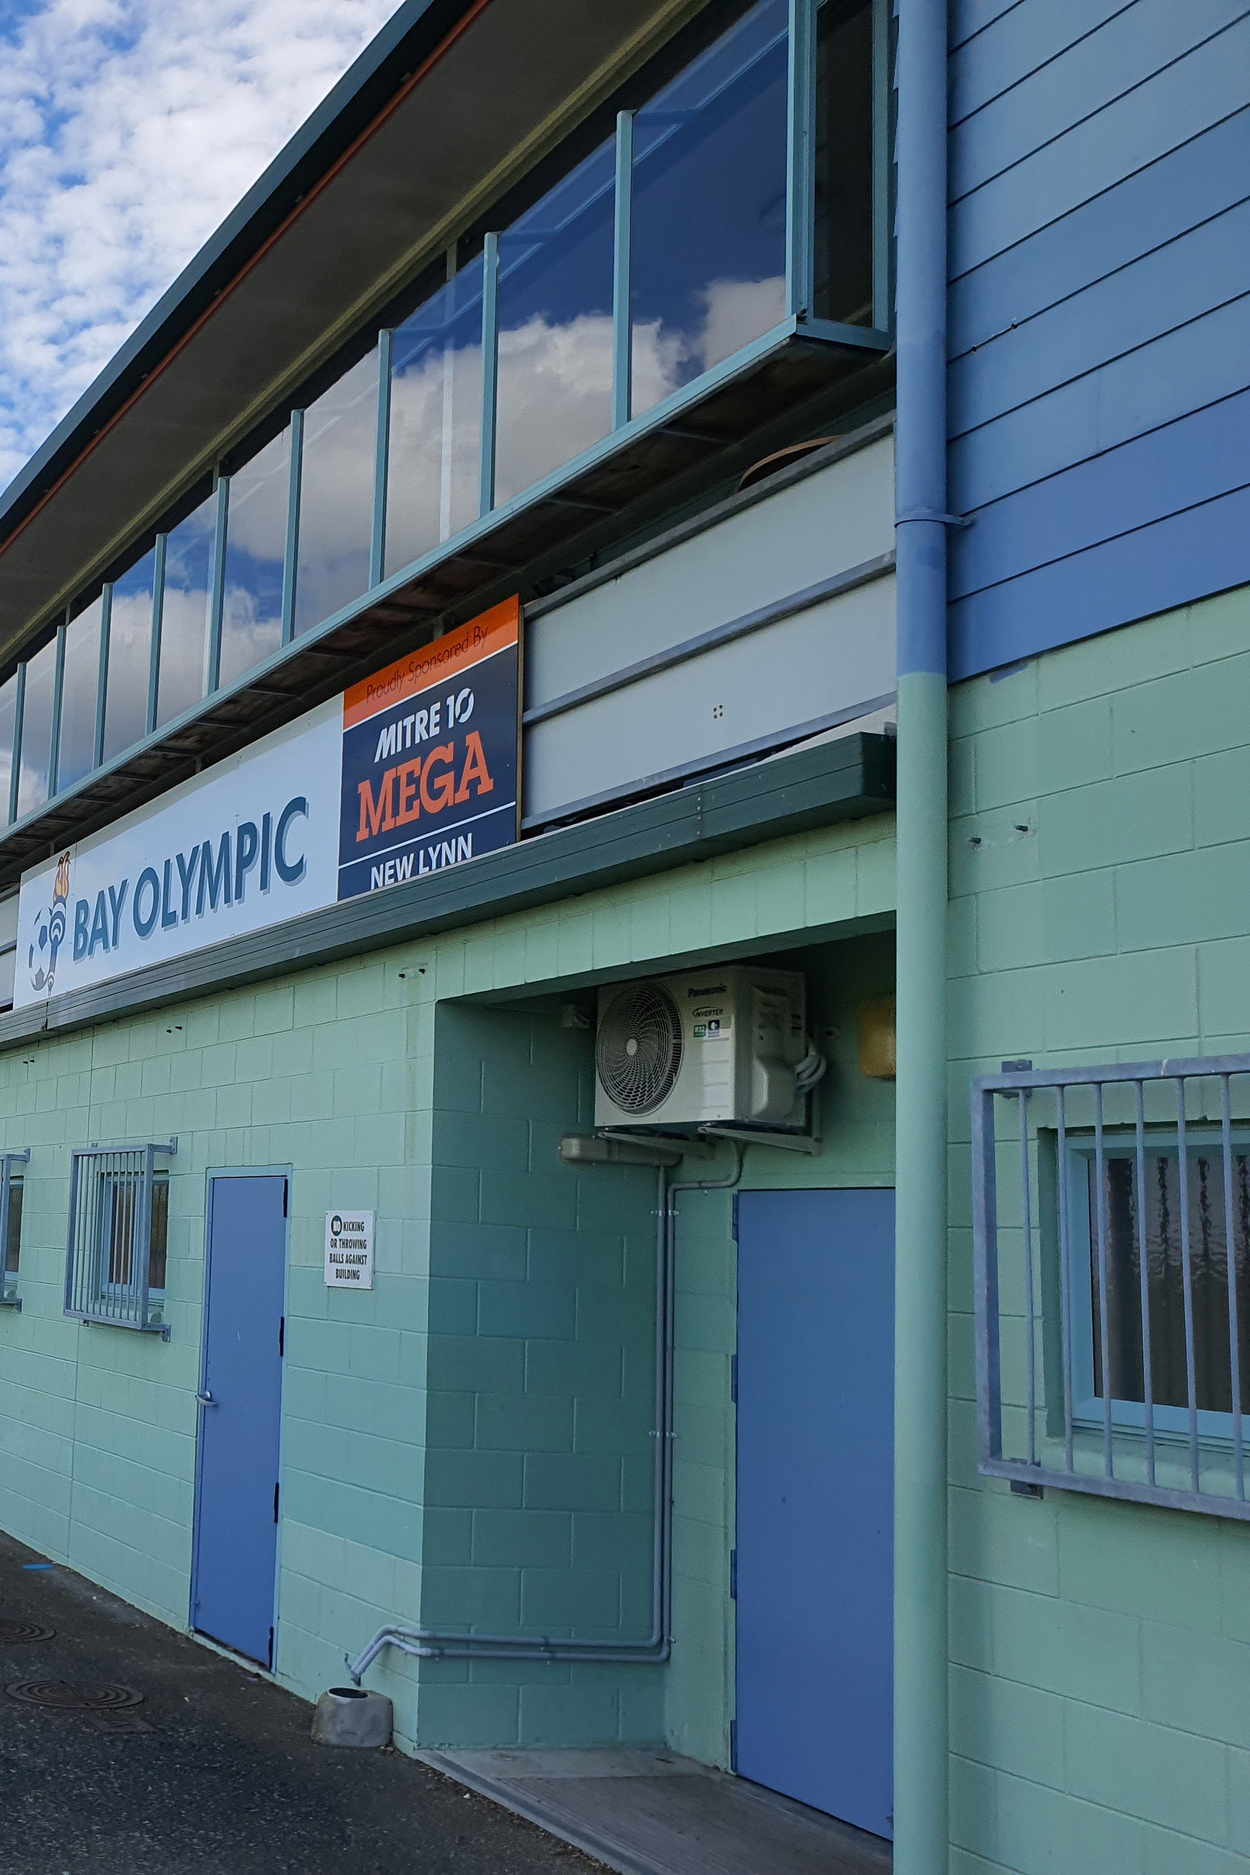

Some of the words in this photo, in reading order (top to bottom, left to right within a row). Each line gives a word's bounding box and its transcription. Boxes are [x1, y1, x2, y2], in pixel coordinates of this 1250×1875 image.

[366, 669, 405, 702] Proudly
[408, 631, 469, 684] Sponsored
[473, 625, 489, 650] By
[374, 701, 440, 763] MITRE
[446, 687, 475, 728] 10
[356, 730, 494, 842] MEGA
[73, 878, 129, 964] BAY
[132, 796, 309, 940] OLYMPIC
[370, 853, 414, 891] NEW
[418, 832, 472, 875] LYNN
[330, 1238, 338, 1248] OR
[339, 1238, 367, 1250] THROWING
[343, 1221, 365, 1232] KICKING
[329, 1253, 344, 1264] BALLS
[345, 1254, 367, 1265] AGAINST
[335, 1268, 360, 1280] BUILDING
